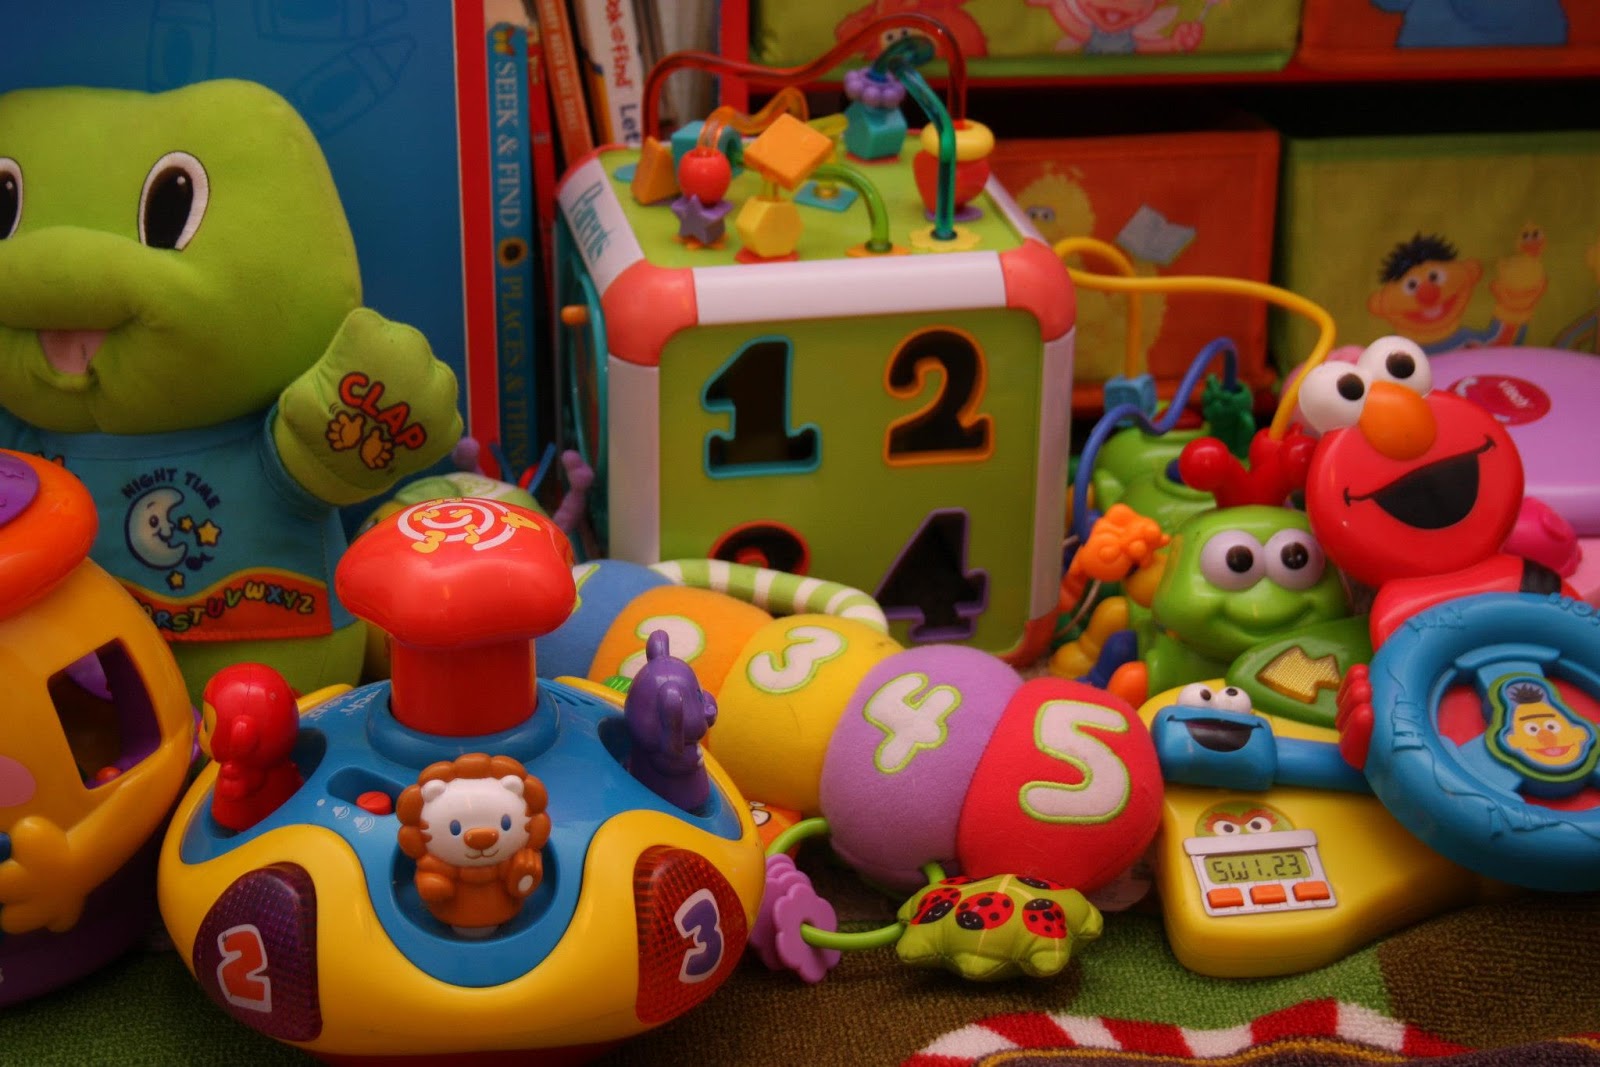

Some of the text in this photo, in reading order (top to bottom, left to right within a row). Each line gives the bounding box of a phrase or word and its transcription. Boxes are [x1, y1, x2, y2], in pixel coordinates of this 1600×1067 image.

[495, 61, 521, 228] SEEK & FIND
[339, 372, 427, 450] CLAP
[702, 325, 995, 479] 1 2
[121, 467, 221, 511] NIGHT TIME
[871, 508, 990, 642] 4
[746, 625, 848, 694] 3
[864, 672, 962, 774] 4
[1019, 699, 1131, 824] 5
[216, 923, 272, 1013] 2
[673, 888, 724, 984] 3
